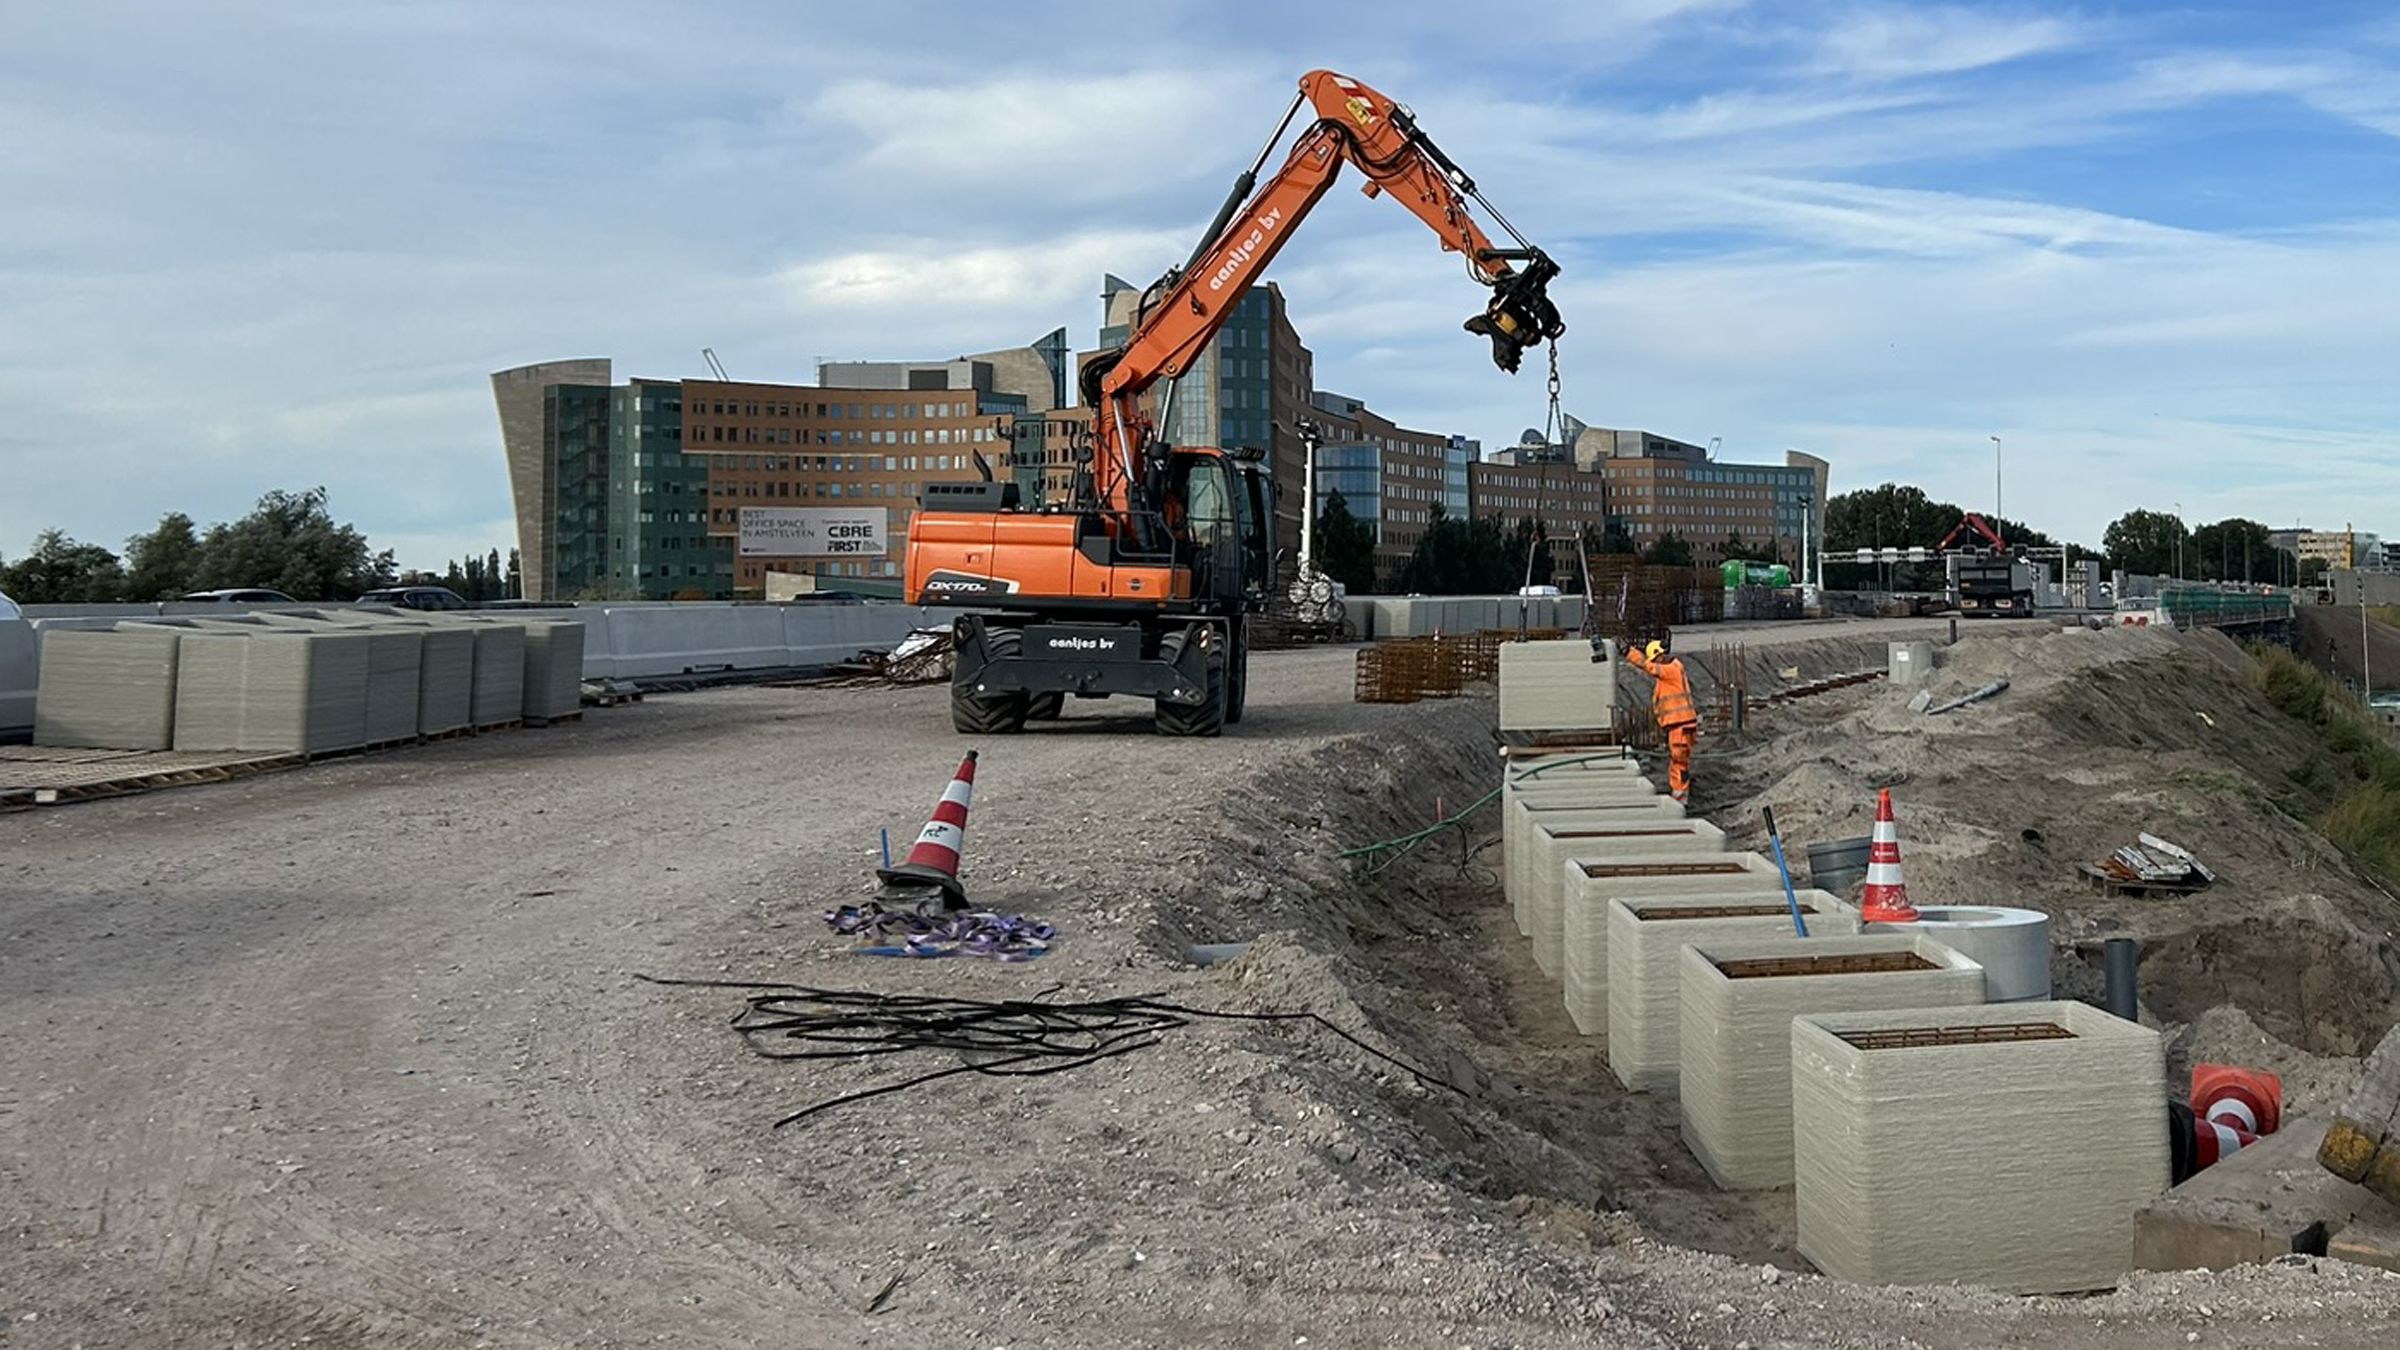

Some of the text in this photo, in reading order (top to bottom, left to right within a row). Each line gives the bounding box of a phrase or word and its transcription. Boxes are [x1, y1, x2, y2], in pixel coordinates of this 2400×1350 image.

[1258, 207, 1281, 230] bv
[743, 519, 805, 528] OFFICE SPACE
[743, 529, 815, 538] IN AMSTELVEEN
[828, 526, 873, 538] CBRE
[828, 540, 862, 552] FIRST
[1099, 638, 1116, 649] bv
